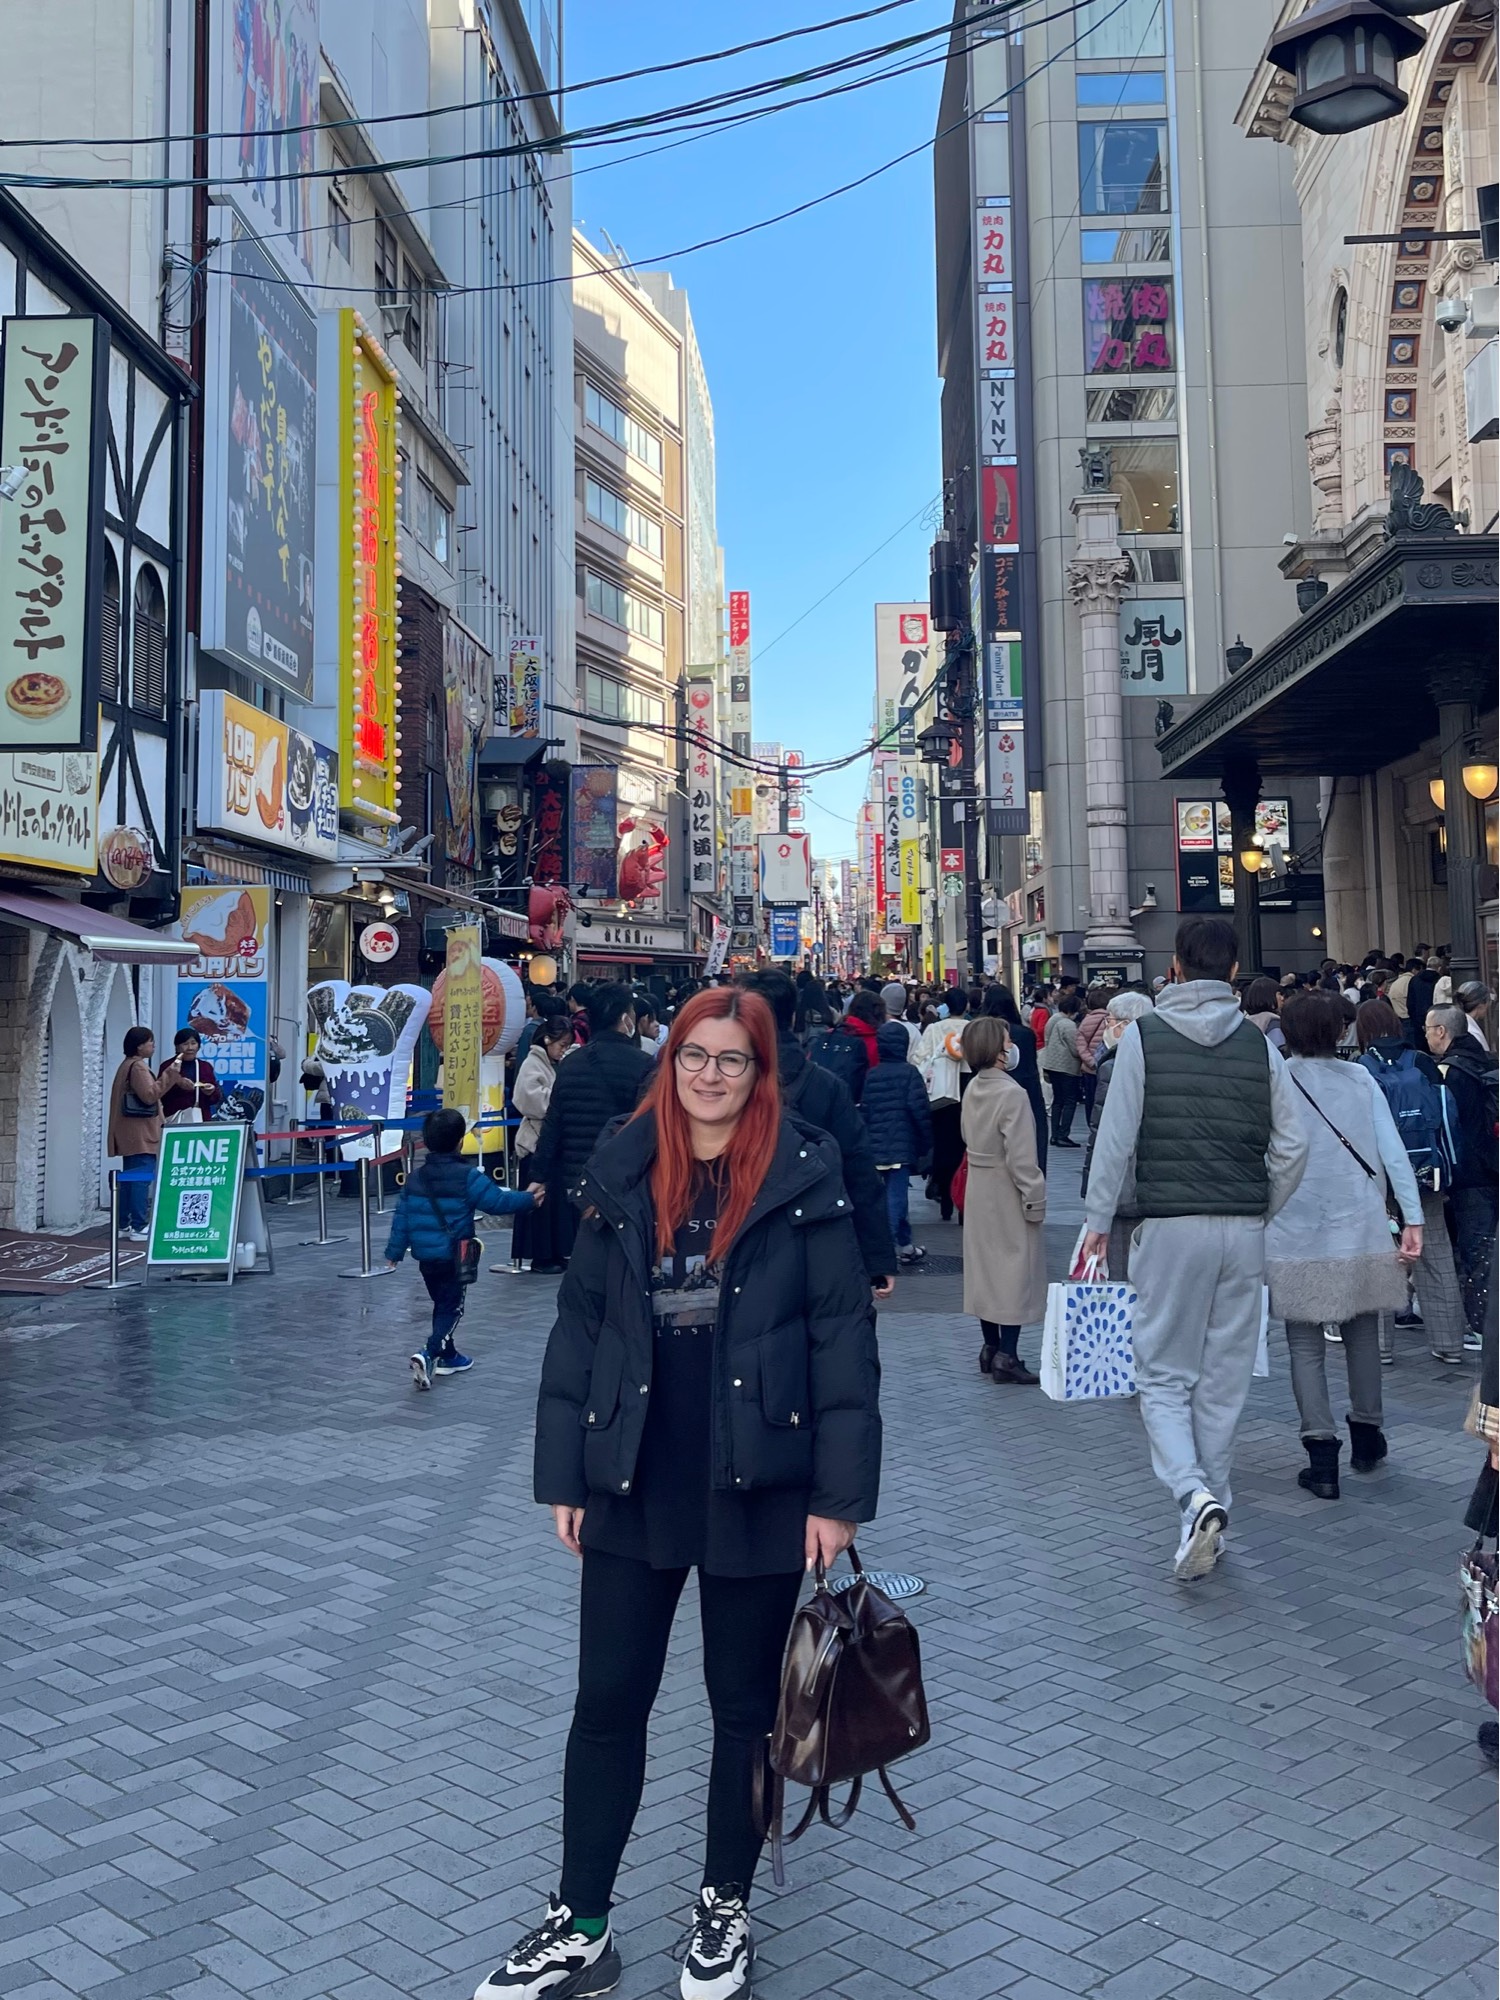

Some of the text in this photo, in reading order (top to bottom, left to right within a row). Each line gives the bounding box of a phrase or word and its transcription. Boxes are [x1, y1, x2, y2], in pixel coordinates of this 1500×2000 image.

[982, 216, 1004, 226] 焼肉
[983, 230, 1005, 274] 力丸
[984, 303, 1006, 312] 焼肉
[1088, 282, 1168, 320] 焼肉
[985, 316, 1007, 361] 力丸
[1092, 331, 1171, 369] 力丸
[990, 381, 1007, 453] NYNY
[13, 341, 79, 660] アンドリューのエッグタルト
[511, 640, 528, 651] 2F
[1124, 614, 1182, 681] 風月
[993, 646, 1005, 697] FamilyMart
[902, 776, 915, 819] GiGO
[692, 788, 713, 882] かに道楽
[944, 852, 960, 868] 本
[171, 1138, 230, 1164] LINE
[169, 1176, 226, 1187] お友達募集中!!
[170, 1164, 227, 1177] 公式アカウント
